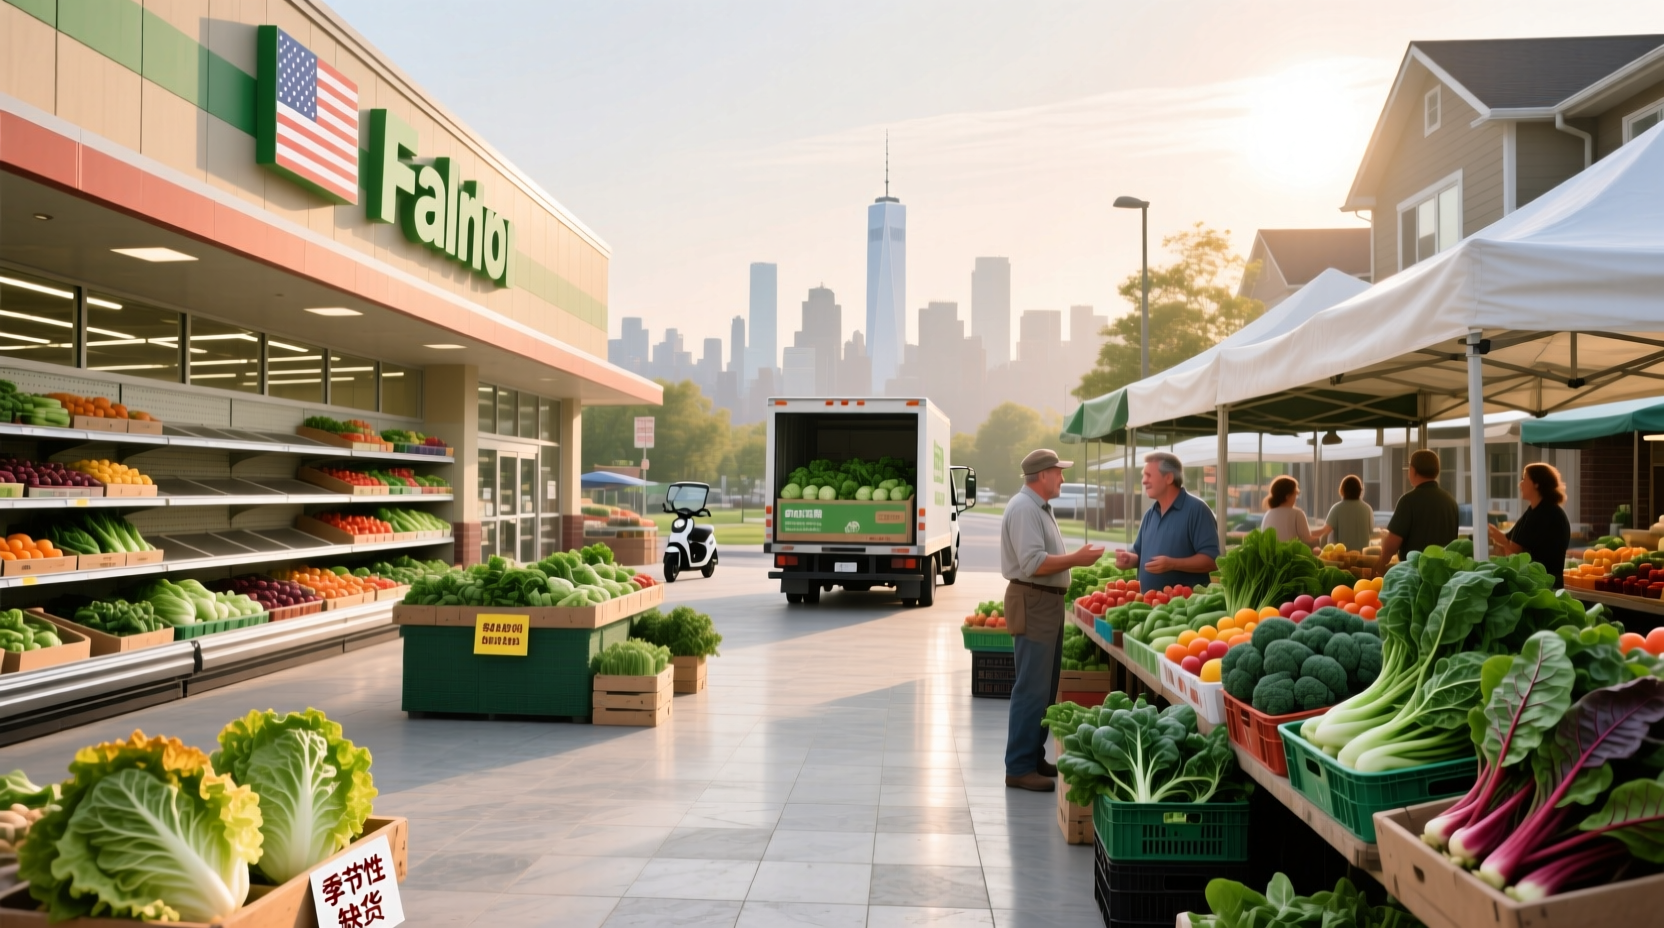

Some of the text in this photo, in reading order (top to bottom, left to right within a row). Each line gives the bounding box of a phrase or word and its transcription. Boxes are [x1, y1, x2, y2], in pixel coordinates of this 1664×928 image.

[322, 853, 386, 907] 季节性
[338, 889, 385, 928] 缺货
